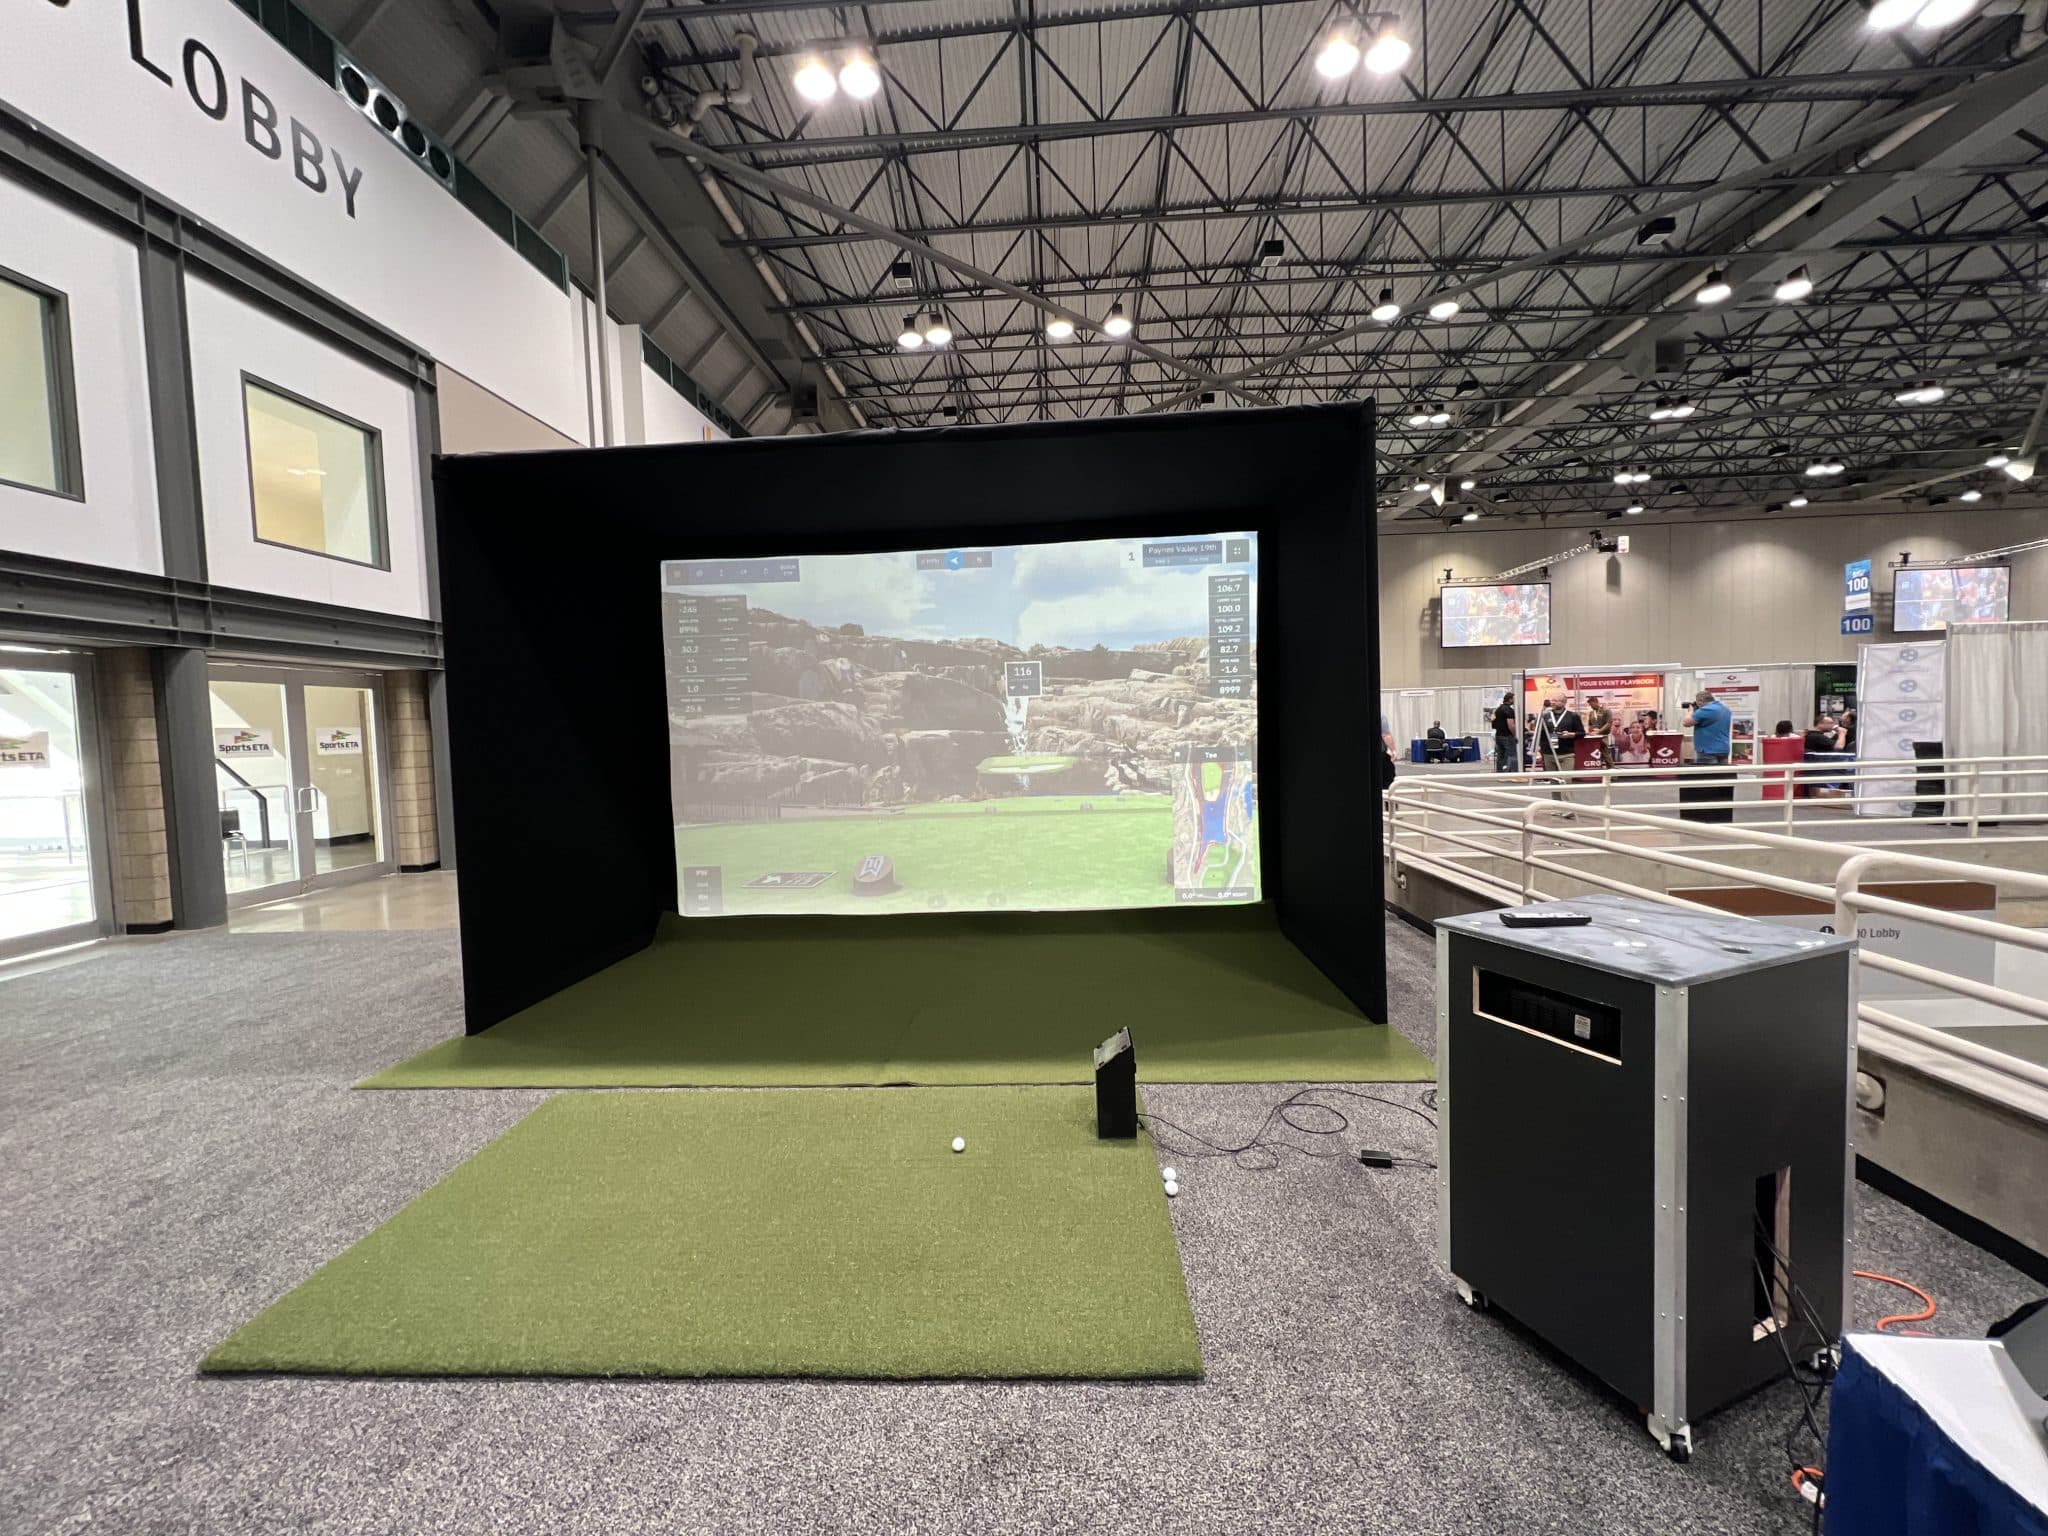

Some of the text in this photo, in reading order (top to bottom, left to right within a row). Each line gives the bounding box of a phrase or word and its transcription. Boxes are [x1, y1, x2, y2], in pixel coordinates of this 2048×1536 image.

[127, 0, 363, 219] LOBBY
[1217, 584, 1240, 593] 106.7
[1846, 577, 1869, 592] 100
[1217, 604, 1241, 613] 100.0
[1217, 625, 1241, 634] 109.2
[1843, 618, 1870, 632] 100
[1220, 645, 1239, 654] 82.7
[1014, 667, 1032, 676] 116
[1599, 679, 1618, 687] EVENT
[219, 743, 270, 754] Sports ETA
[319, 741, 359, 751] Sports ETA
[18, 751, 46, 761] ETA
[1870, 928, 1901, 939] Lobby
